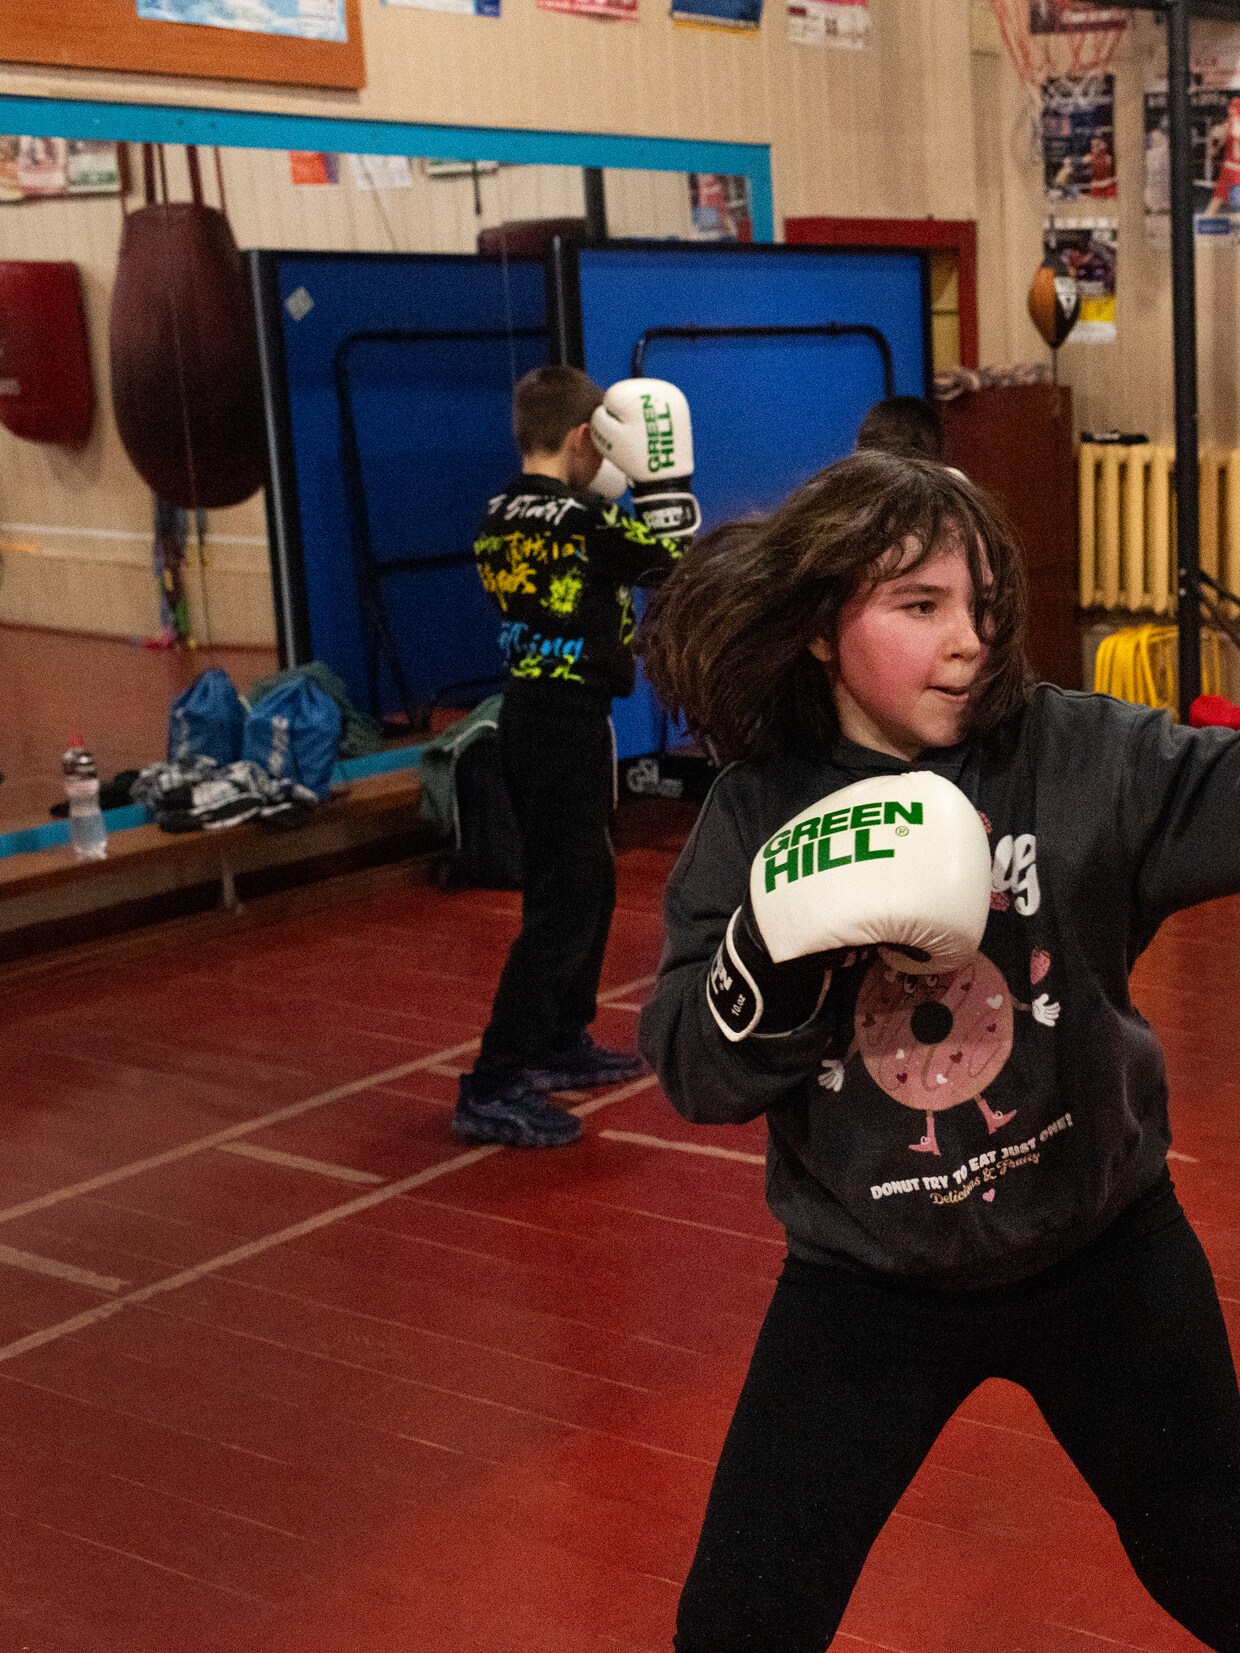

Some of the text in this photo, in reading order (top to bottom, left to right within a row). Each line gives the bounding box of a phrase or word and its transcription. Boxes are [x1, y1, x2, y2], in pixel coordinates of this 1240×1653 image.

[640, 394, 662, 473] GREEN
[657, 402, 675, 468] HILL
[762, 801, 924, 859] GREEN
[764, 828, 895, 893] HILL
[870, 1178, 921, 1200] DONUT
[922, 1175, 949, 1191] TRY
[952, 1164, 968, 1184] TO
[968, 1150, 998, 1172] EAT
[1001, 1137, 1037, 1158] JUST
